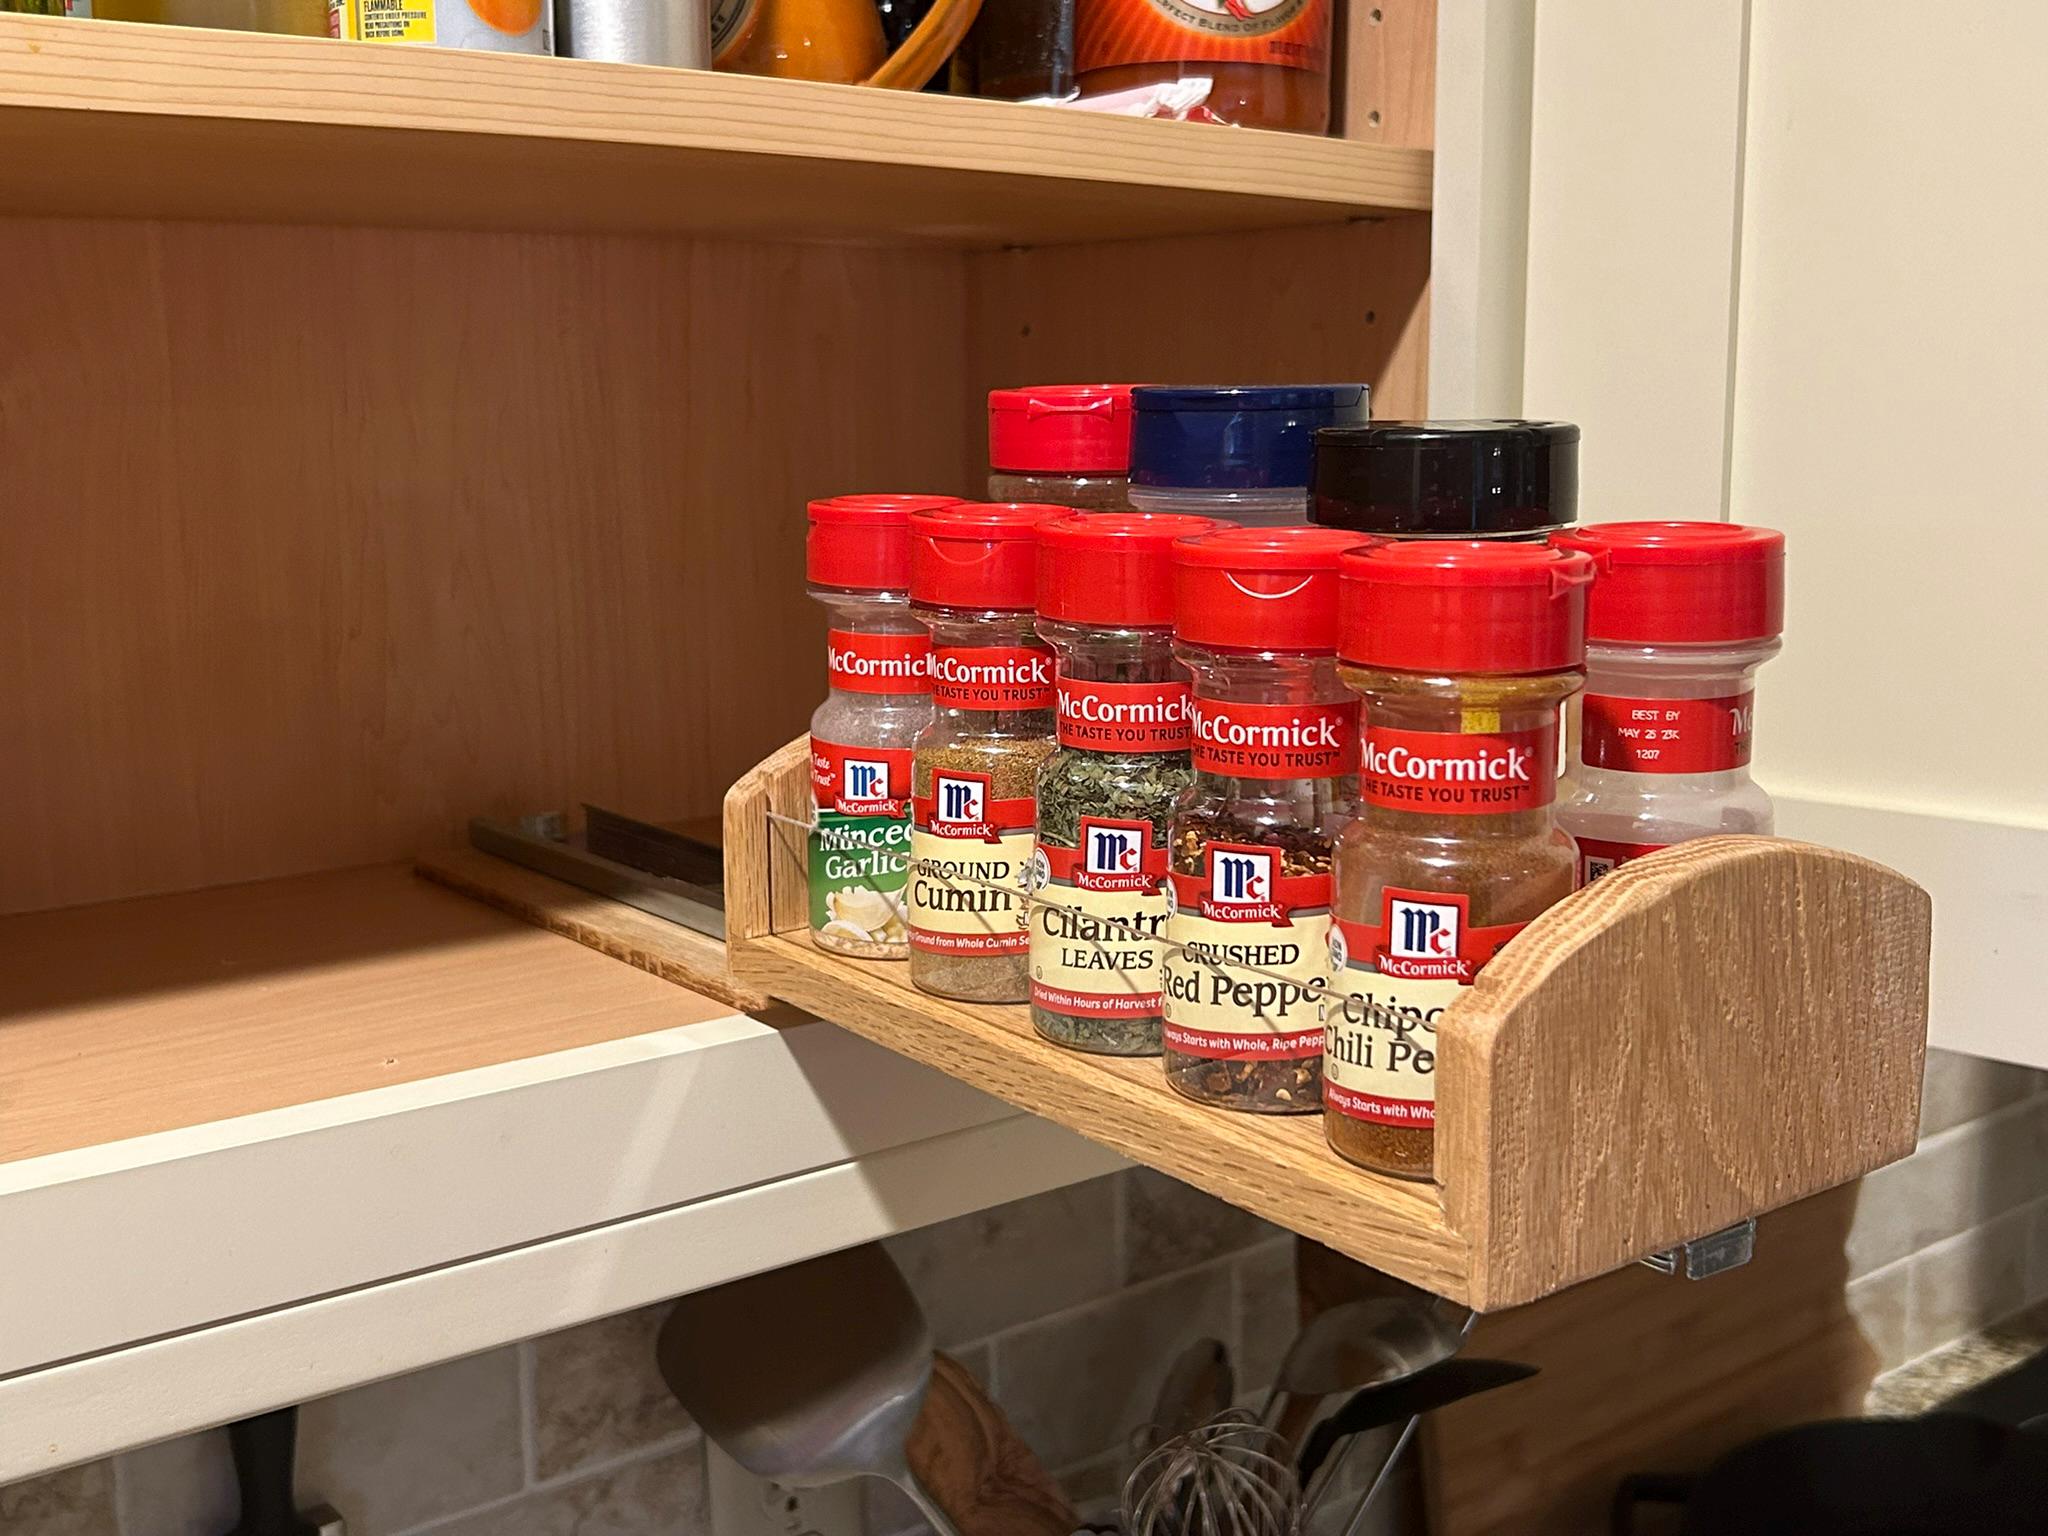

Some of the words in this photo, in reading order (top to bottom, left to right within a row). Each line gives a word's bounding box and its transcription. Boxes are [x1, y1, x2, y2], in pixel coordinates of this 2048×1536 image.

[926, 652, 1050, 685] McCormick
[940, 685, 969, 700] TASTE
[973, 688, 999, 701] YOU
[1003, 687, 1042, 701] TRUST
[1057, 688, 1195, 723] McCormick
[1631, 709, 1660, 721] BEST
[1665, 710, 1680, 722] BY
[1076, 724, 1112, 741] TASTE
[1116, 729, 1146, 742] YOU
[1150, 725, 1192, 741] TRUST
[1192, 702, 1341, 748] McCormick
[1618, 727, 1641, 739] MAY
[1206, 746, 1244, 765] TASTE
[1249, 751, 1280, 767] YOU
[1285, 751, 1333, 767] TRUST
[1361, 738, 1530, 781] McCormick
[1636, 749, 1660, 761] 1207
[1381, 782, 1423, 801] TASTE
[1429, 787, 1465, 803] YOU
[1470, 785, 1520, 803] TRUST
[838, 800, 898, 813] McCormick
[930, 819, 992, 837] McCormick
[825, 848, 909, 879] Garlic
[916, 858, 1010, 881] GROUND
[1077, 871, 1151, 889] McCormick
[914, 879, 1012, 912] Cumin
[1202, 900, 1282, 920] McCormick
[936, 935, 955, 948] from
[956, 938, 984, 948] Whole
[986, 936, 1017, 948] Cumin
[1061, 947, 1154, 970] LEAVES
[1182, 941, 1300, 967] CRUSHED
[1378, 954, 1470, 976] McCormick
[1048, 991, 1072, 1006] Within
[1074, 996, 1101, 1009] Hours
[1103, 996, 1113, 1009] of
[1116, 997, 1156, 1010] Harvest
[1163, 965, 1201, 1004] Red
[1210, 975, 1329, 1018] Peppe
[1183, 1032, 1208, 1047] Starts
[1209, 1037, 1231, 1050] with
[1233, 1038, 1270, 1052] Whole,
[1272, 1037, 1297, 1052] Ripe
[1325, 1024, 1373, 1069] Chili
[1351, 1096, 1381, 1115] Starts
[1383, 1104, 1408, 1118] with
